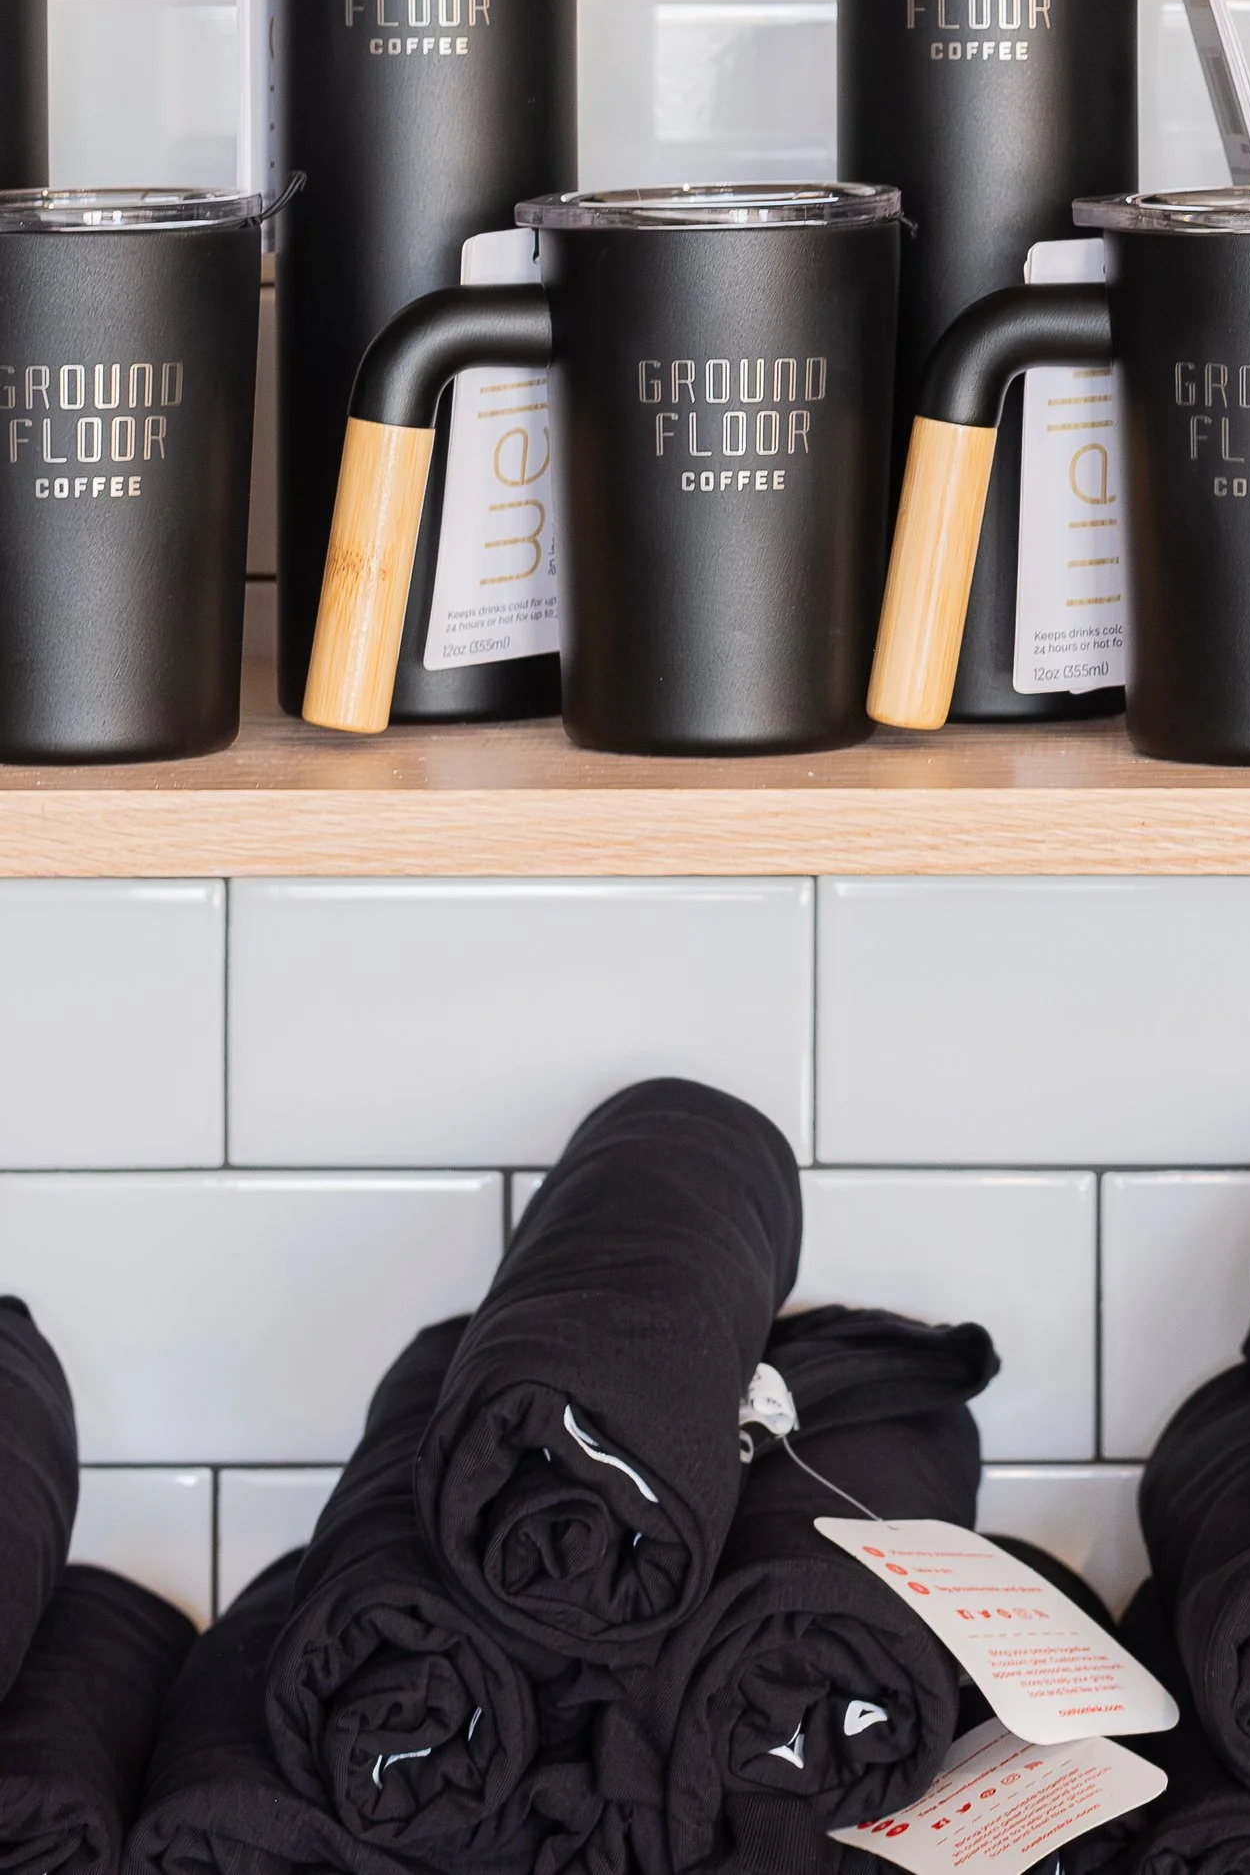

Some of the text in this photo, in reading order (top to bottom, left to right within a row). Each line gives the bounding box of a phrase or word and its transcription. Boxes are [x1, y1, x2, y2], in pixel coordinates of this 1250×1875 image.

[370, 37, 468, 55] COFFEE
[930, 41, 1029, 61] COFFEE
[639, 358, 826, 403] GROUND
[10, 416, 166, 463] FLOOR
[656, 411, 810, 456] FLOOR
[36, 476, 141, 498] COFFEE
[478, 375, 551, 586] well
[682, 470, 785, 491] COFFEE
[448, 610, 476, 620] Keeps
[478, 605, 506, 616] drinks
[508, 599, 529, 611] cold
[530, 597, 543, 607] for
[445, 609, 554, 633] 24 hours or hot for up to
[1034, 630, 1066, 642] Keeps
[1069, 626, 1100, 639] drinks
[442, 636, 511, 658] 12oz (355ml)
[1033, 637, 1123, 655] 24 hours or hot fo
[1033, 661, 1109, 681] 12oz (355ml)
